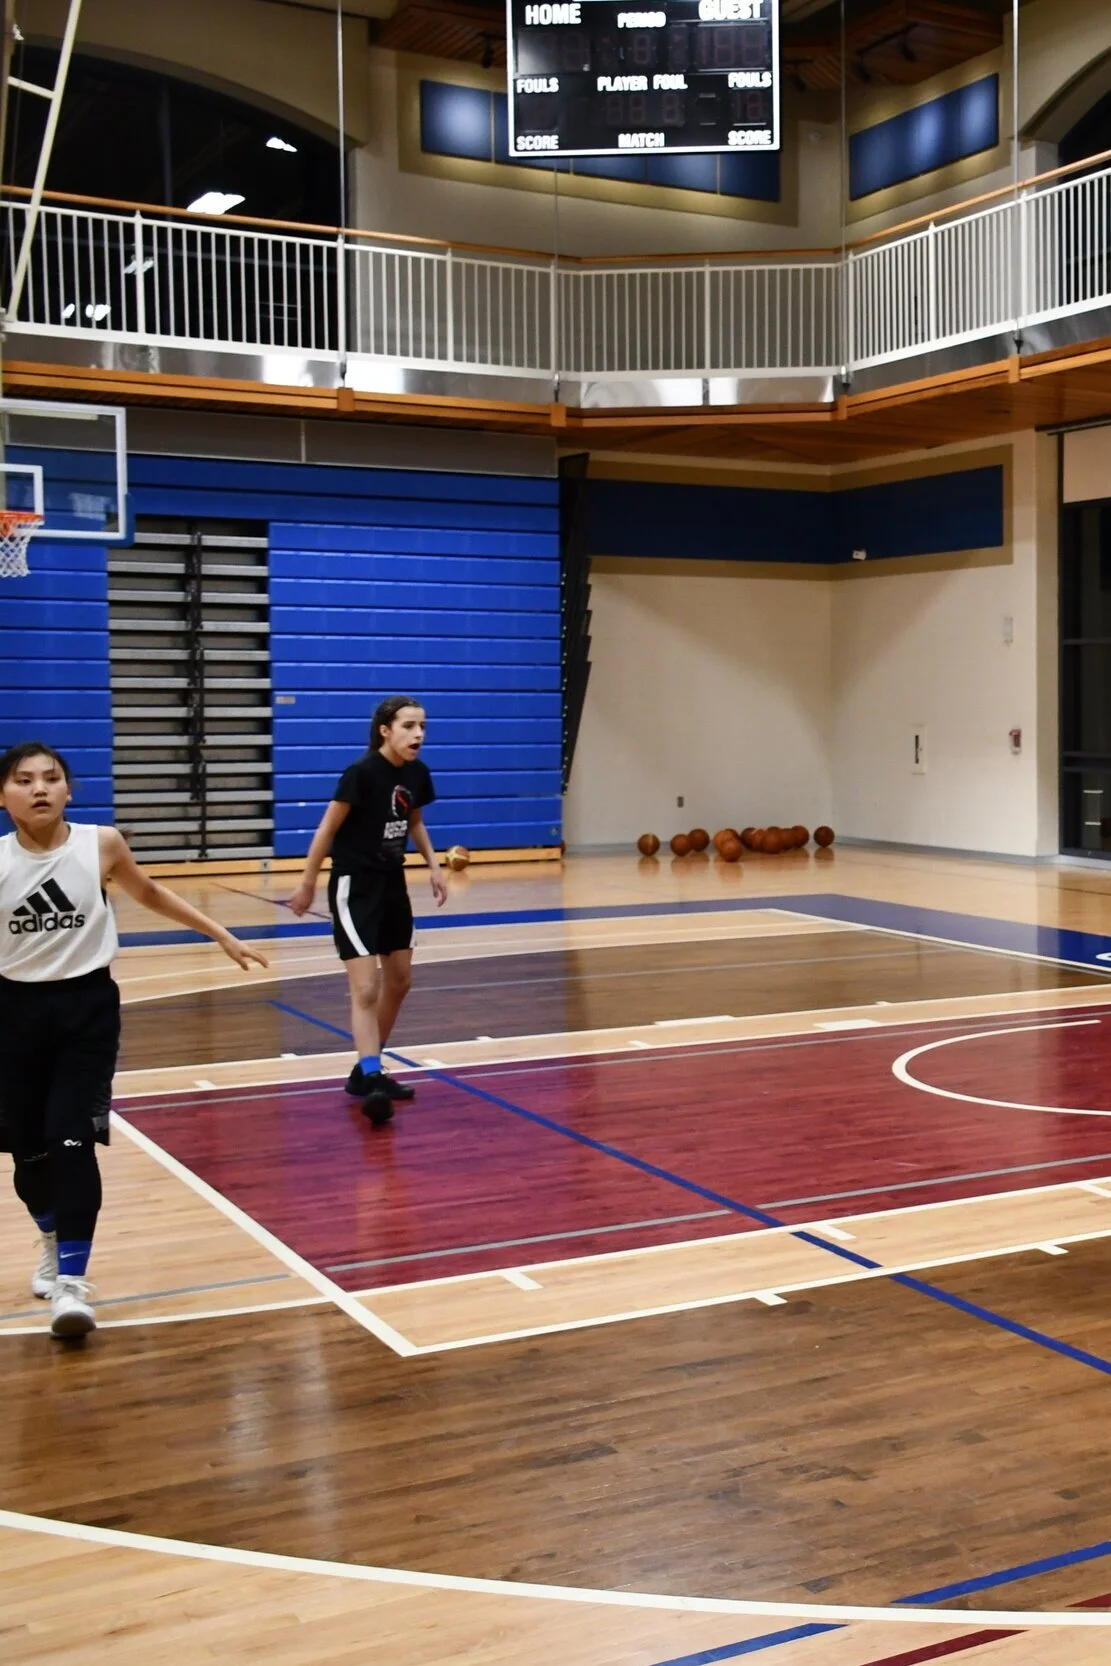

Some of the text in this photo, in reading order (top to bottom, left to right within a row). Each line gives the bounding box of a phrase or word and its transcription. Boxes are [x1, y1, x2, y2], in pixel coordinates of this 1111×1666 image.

[525, 3, 582, 25] HOME
[698, 0, 764, 20] GUEST
[516, 78, 560, 94] FOULS
[597, 74, 689, 91] PLAYER FOUL
[728, 71, 773, 89] FOULS
[516, 135, 560, 151] SCORE
[617, 132, 665, 149] MATCH
[728, 129, 772, 146] SCORE
[8, 912, 86, 935] adidas
